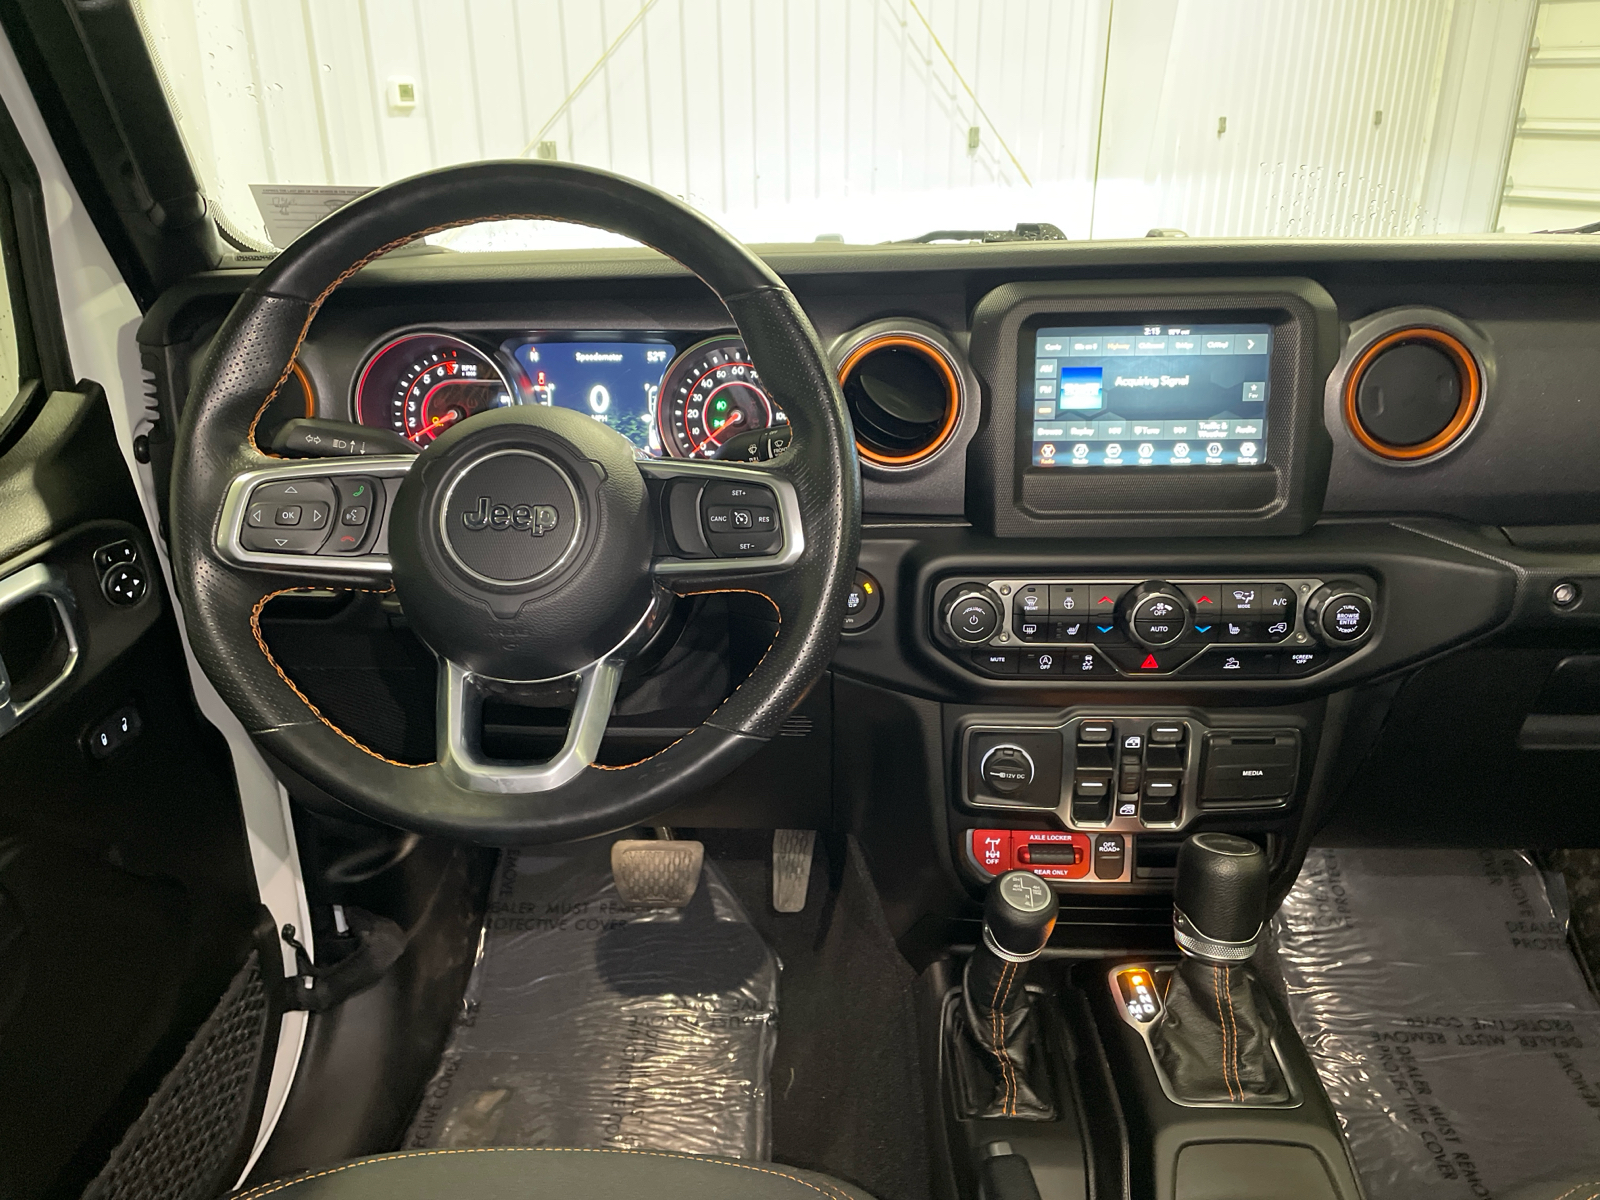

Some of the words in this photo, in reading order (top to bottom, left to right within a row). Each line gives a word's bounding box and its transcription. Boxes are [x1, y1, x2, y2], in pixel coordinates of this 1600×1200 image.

[529, 351, 539, 362] N
[575, 352, 623, 363] Speedometer
[437, 367, 444, 376] 6
[452, 364, 459, 374] 7
[716, 370, 726, 378] 50
[731, 366, 744, 375] 60
[423, 374, 431, 384] 5
[701, 379, 713, 388] 40
[1115, 376, 1158, 388] Acquiring
[1161, 375, 1189, 387] Signal
[413, 386, 420, 396] 4
[589, 384, 610, 413] 0
[692, 394, 702, 402] 30
[408, 401, 416, 411] 3
[687, 409, 699, 418] 20
[408, 417, 416, 427] 2
[692, 427, 699, 435] 10
[282, 511, 295, 519] OK
[462, 496, 559, 537] Jeep
[1272, 598, 1287, 607] A/C
[546, 901, 589, 915] MUST
[574, 918, 628, 932] COVER
[1369, 1031, 1447, 1046] REMOVE
[1457, 1033, 1506, 1046] MUST
[1375, 1044, 1430, 1125] PROTECTIVE
[1420, 1131, 1459, 1181] COVER
[1395, 1045, 1433, 1095] DEALER
[1424, 1104, 1462, 1144] MUST
[1452, 1152, 1491, 1200] REMO
